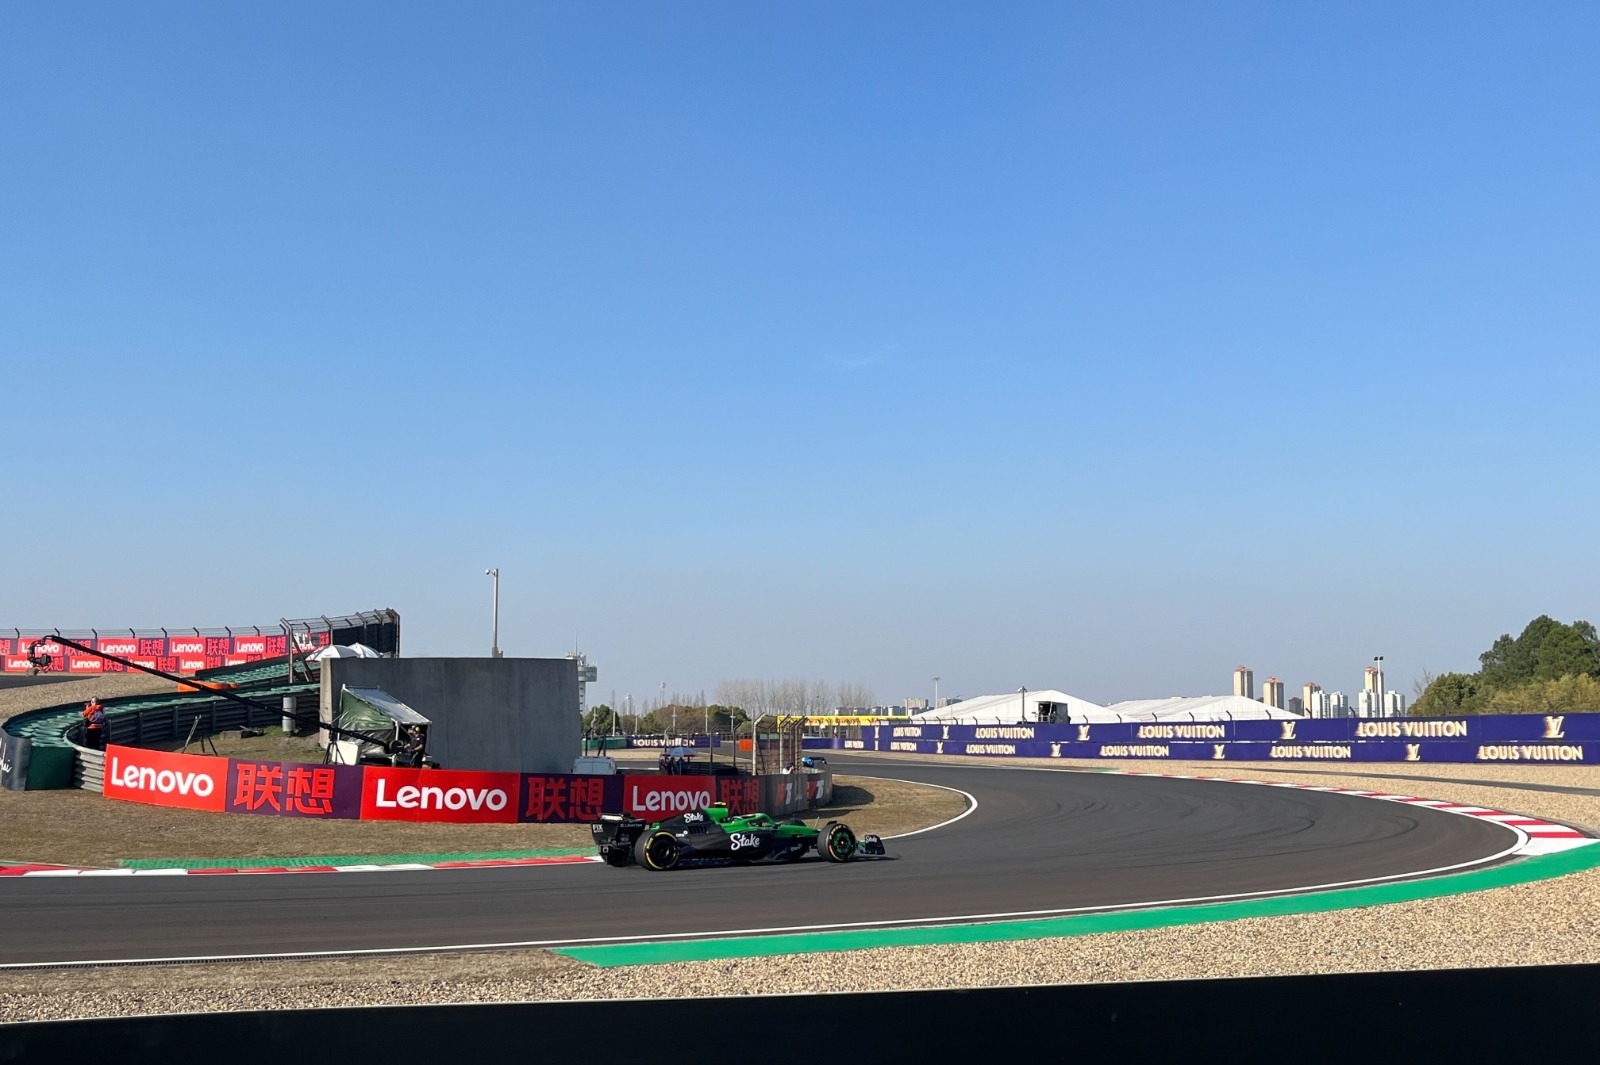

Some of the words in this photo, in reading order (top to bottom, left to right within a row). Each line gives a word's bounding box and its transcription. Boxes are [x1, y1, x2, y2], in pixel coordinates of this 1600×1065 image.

[21, 642, 59, 653] Lnovo
[101, 642, 136, 654] Lenovo
[140, 639, 164, 656] 联想
[172, 641, 203, 653] Lenovo
[207, 638, 229, 655] 联想
[236, 641, 264, 653] Lenovo
[72, 659, 100, 669] Lenovo
[182, 660, 204, 669] Lenovo
[975, 727, 997, 738] LOUIS
[998, 727, 1034, 738] VUITTON
[1137, 725, 1173, 738] LOUIS
[1174, 725, 1225, 738] VUITTON
[1356, 721, 1400, 737] LOUIS
[1402, 721, 1467, 737] VUITTON
[966, 744, 984, 754] LOUIS
[985, 744, 1015, 754] VUITTON
[1100, 745, 1128, 757] LOUIS
[1129, 745, 1169, 757] VUITTON
[1269, 745, 1302, 759] LOUIS
[1303, 745, 1351, 759] VUITTON
[1477, 746, 1519, 761] LOUIS
[1521, 746, 1583, 761] VUITTON
[111, 757, 213, 797] Lenovo
[235, 763, 335, 814] 联想
[376, 779, 507, 811] Lenovo
[526, 777, 604, 821] 联想
[632, 786, 710, 811] Lenovo
[720, 779, 759, 816] 联想
[684, 813, 704, 823] Stake
[730, 833, 760, 850] Stake
